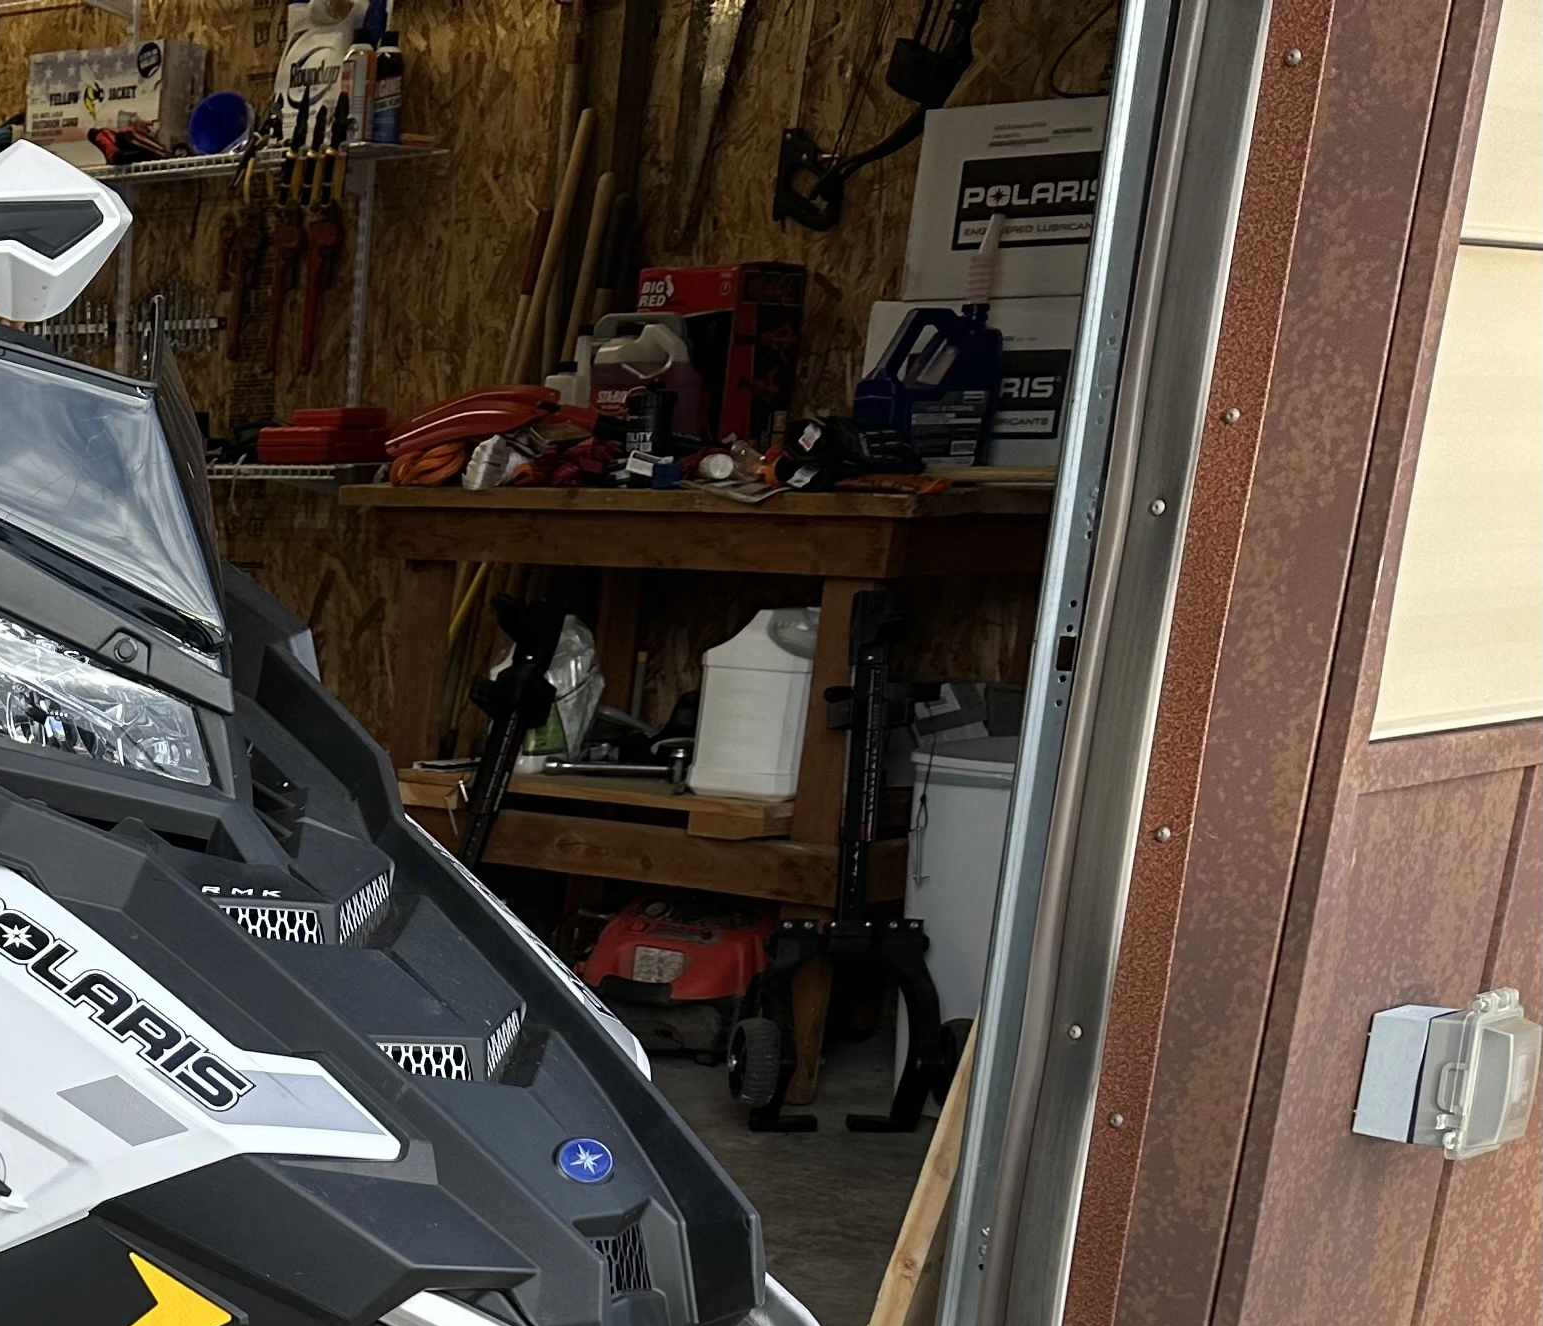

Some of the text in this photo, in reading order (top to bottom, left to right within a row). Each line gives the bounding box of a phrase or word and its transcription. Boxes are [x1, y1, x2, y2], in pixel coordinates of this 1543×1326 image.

[290, 60, 341, 88] Roundup
[641, 280, 665, 294] BIG
[638, 294, 666, 307] RED
[201, 885, 281, 898] RMK
